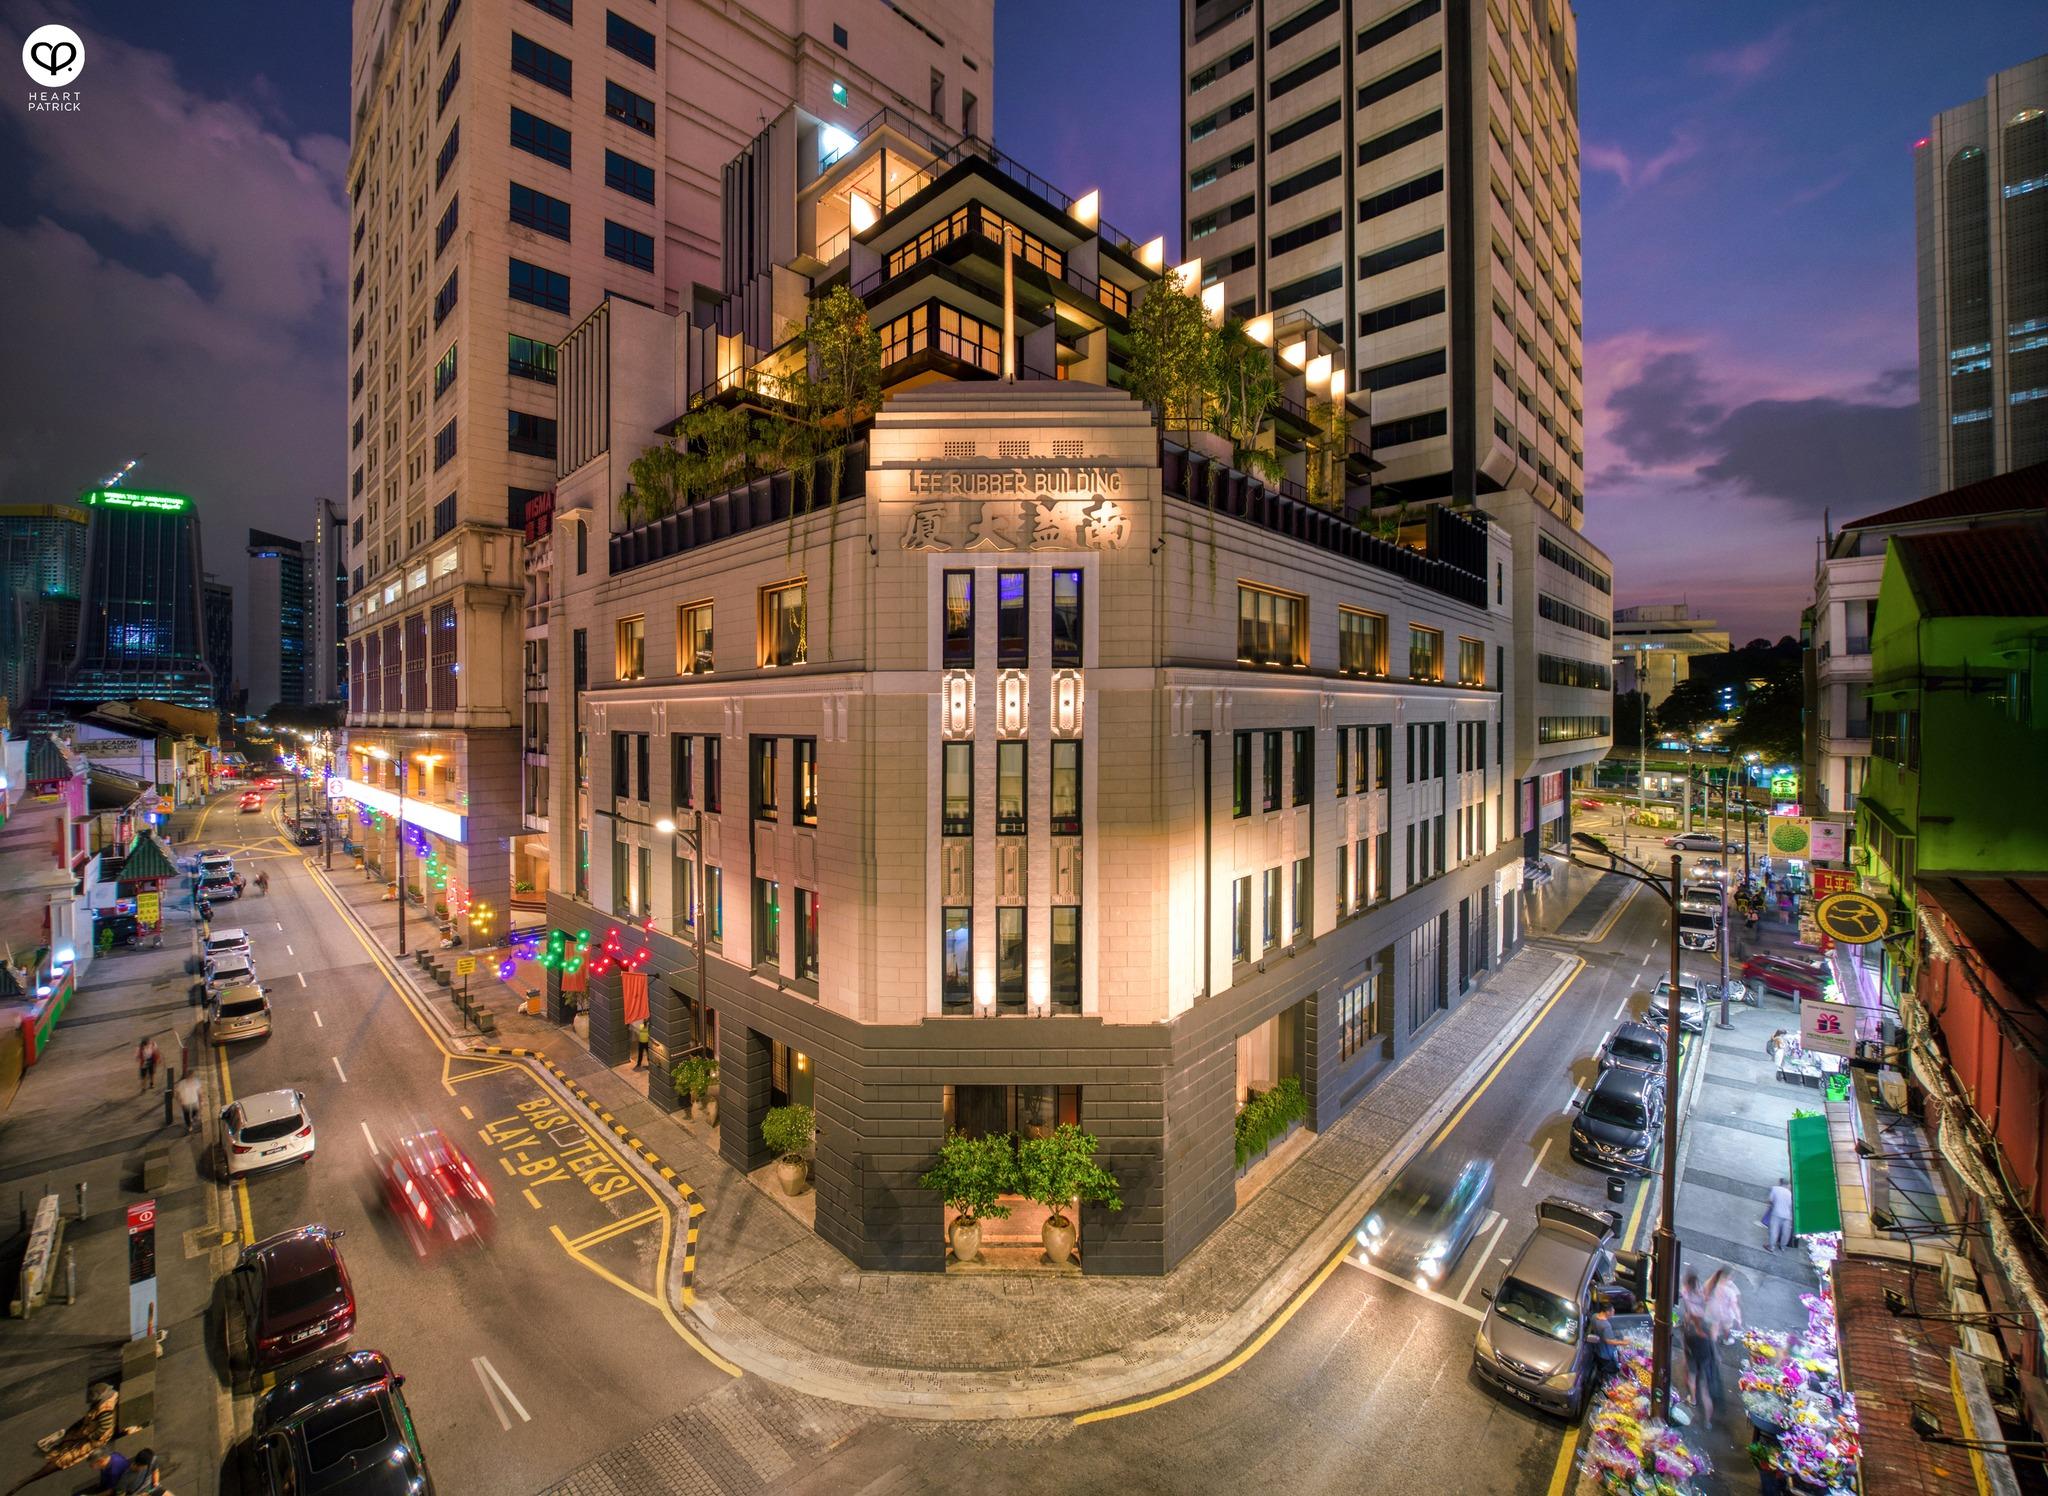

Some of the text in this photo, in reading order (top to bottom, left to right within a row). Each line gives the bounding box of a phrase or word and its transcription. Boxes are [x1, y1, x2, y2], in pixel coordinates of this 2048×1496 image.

[909, 473, 1121, 494] LEE RUBBER BUILDING
[485, 1116, 571, 1188] LAY-BY
[516, 1097, 639, 1203] BAS TEKSI
